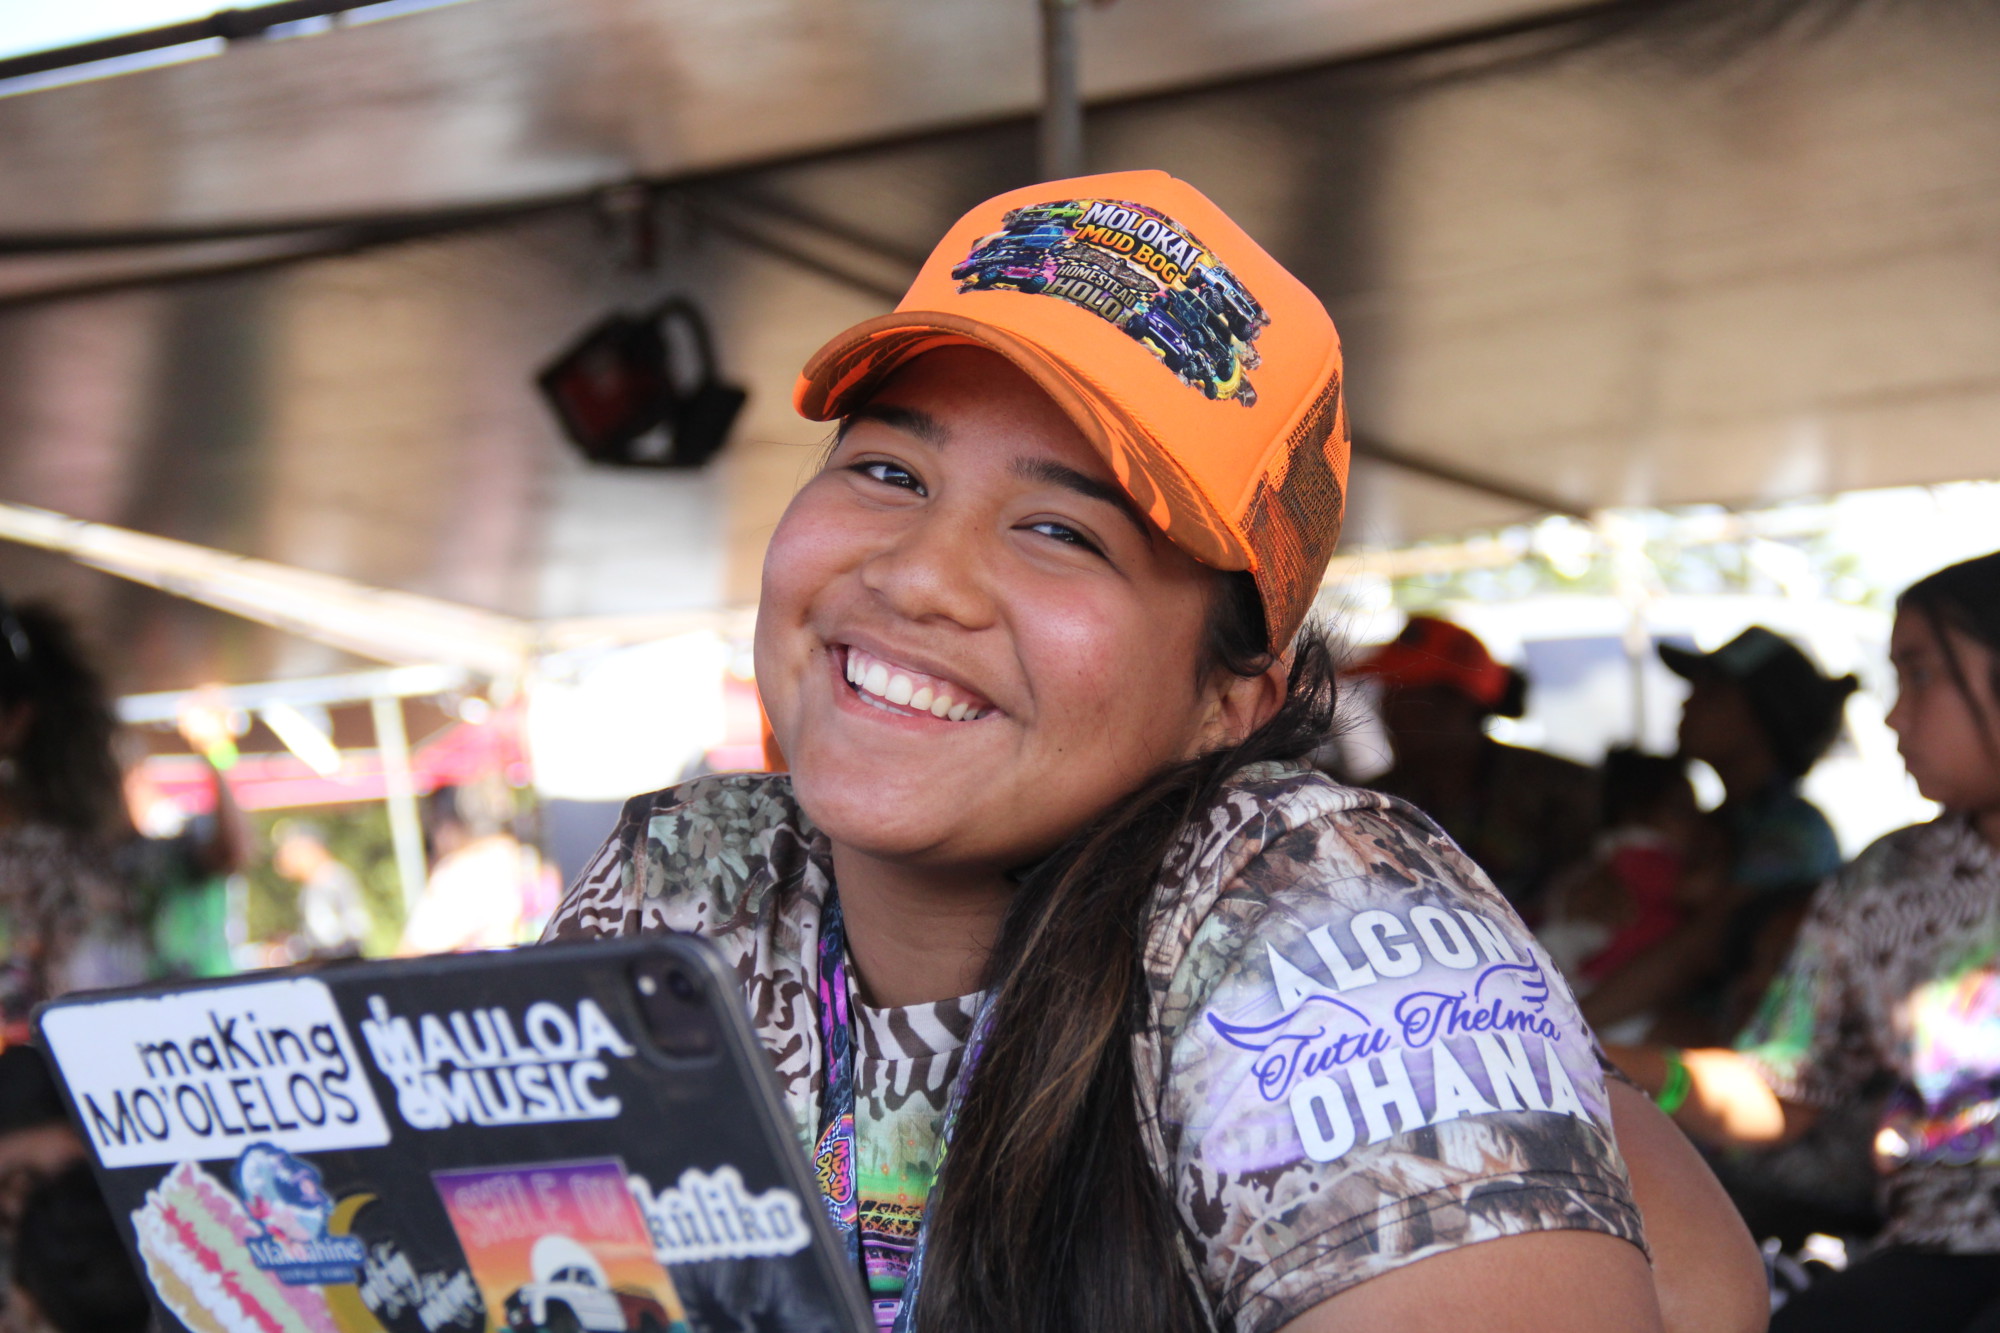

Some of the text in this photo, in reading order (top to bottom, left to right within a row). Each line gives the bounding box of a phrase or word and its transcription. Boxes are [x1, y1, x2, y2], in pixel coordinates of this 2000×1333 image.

[1076, 224, 1179, 284] MUD BOG
[1078, 201, 1202, 275] MOLOKAI
[1049, 277, 1123, 322] HOLO
[1056, 264, 1137, 309] HOMESTEAD
[1251, 990, 1561, 1101] Tutu Thelma
[422, 1059, 622, 1127] MUSIC
[1289, 1032, 1598, 1164] OHANA
[831, 1140, 851, 1202] CREW
